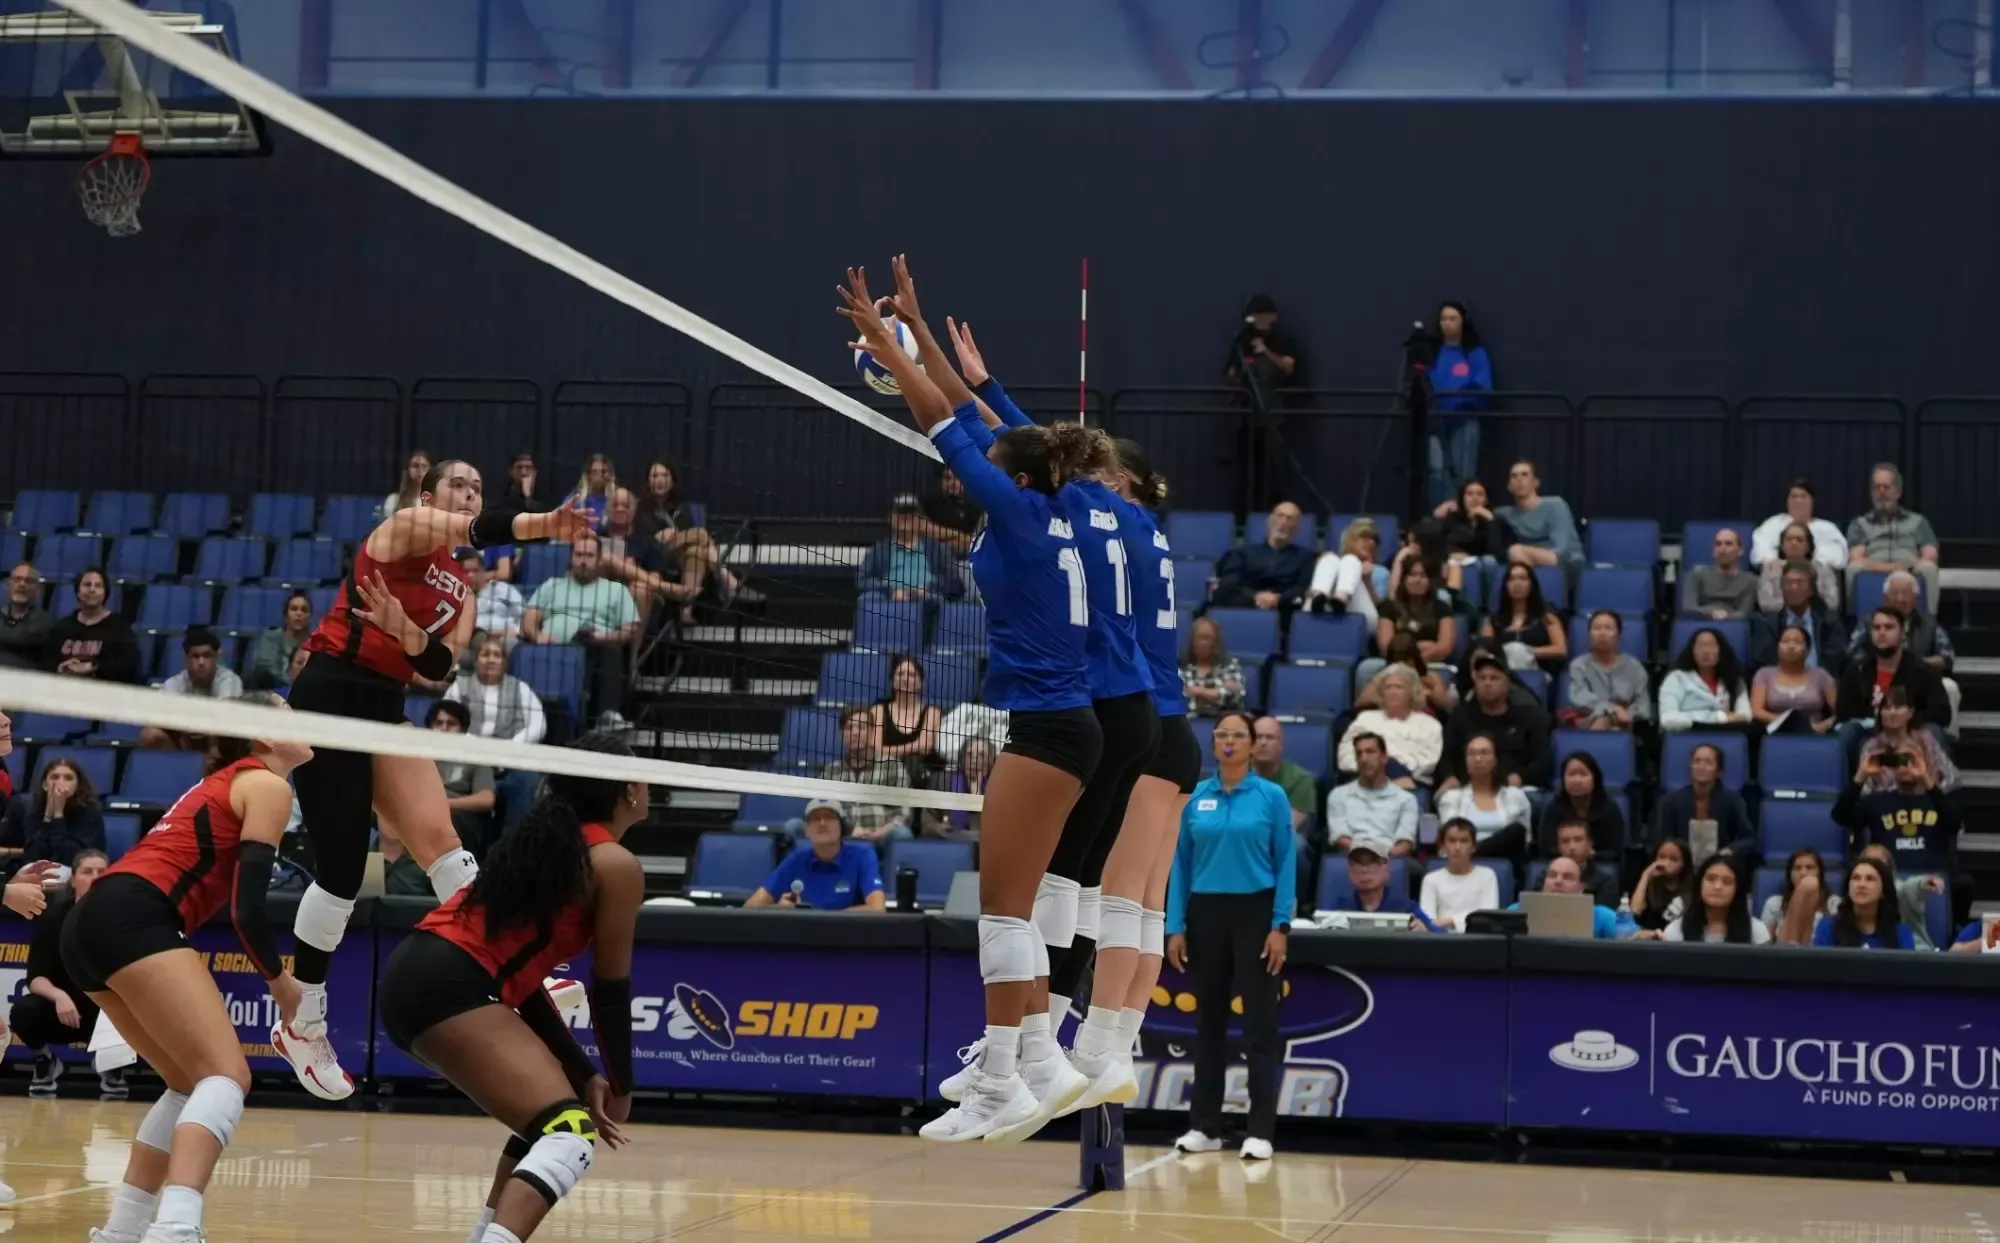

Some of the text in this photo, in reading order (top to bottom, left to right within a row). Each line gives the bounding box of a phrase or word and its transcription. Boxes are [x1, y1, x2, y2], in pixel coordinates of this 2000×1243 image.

[425, 599, 456, 634] 7
[735, 1001, 879, 1040] SHOP
[691, 1050, 730, 1062] Where
[731, 1051, 781, 1064] Gauchos
[784, 1053, 805, 1065] Get
[808, 1054, 841, 1066] Their
[843, 1056, 876, 1068] Gear!
[1803, 1089, 1816, 1104] A
[1821, 1089, 1872, 1106] FUND
[1878, 1091, 1916, 1108] FOR
